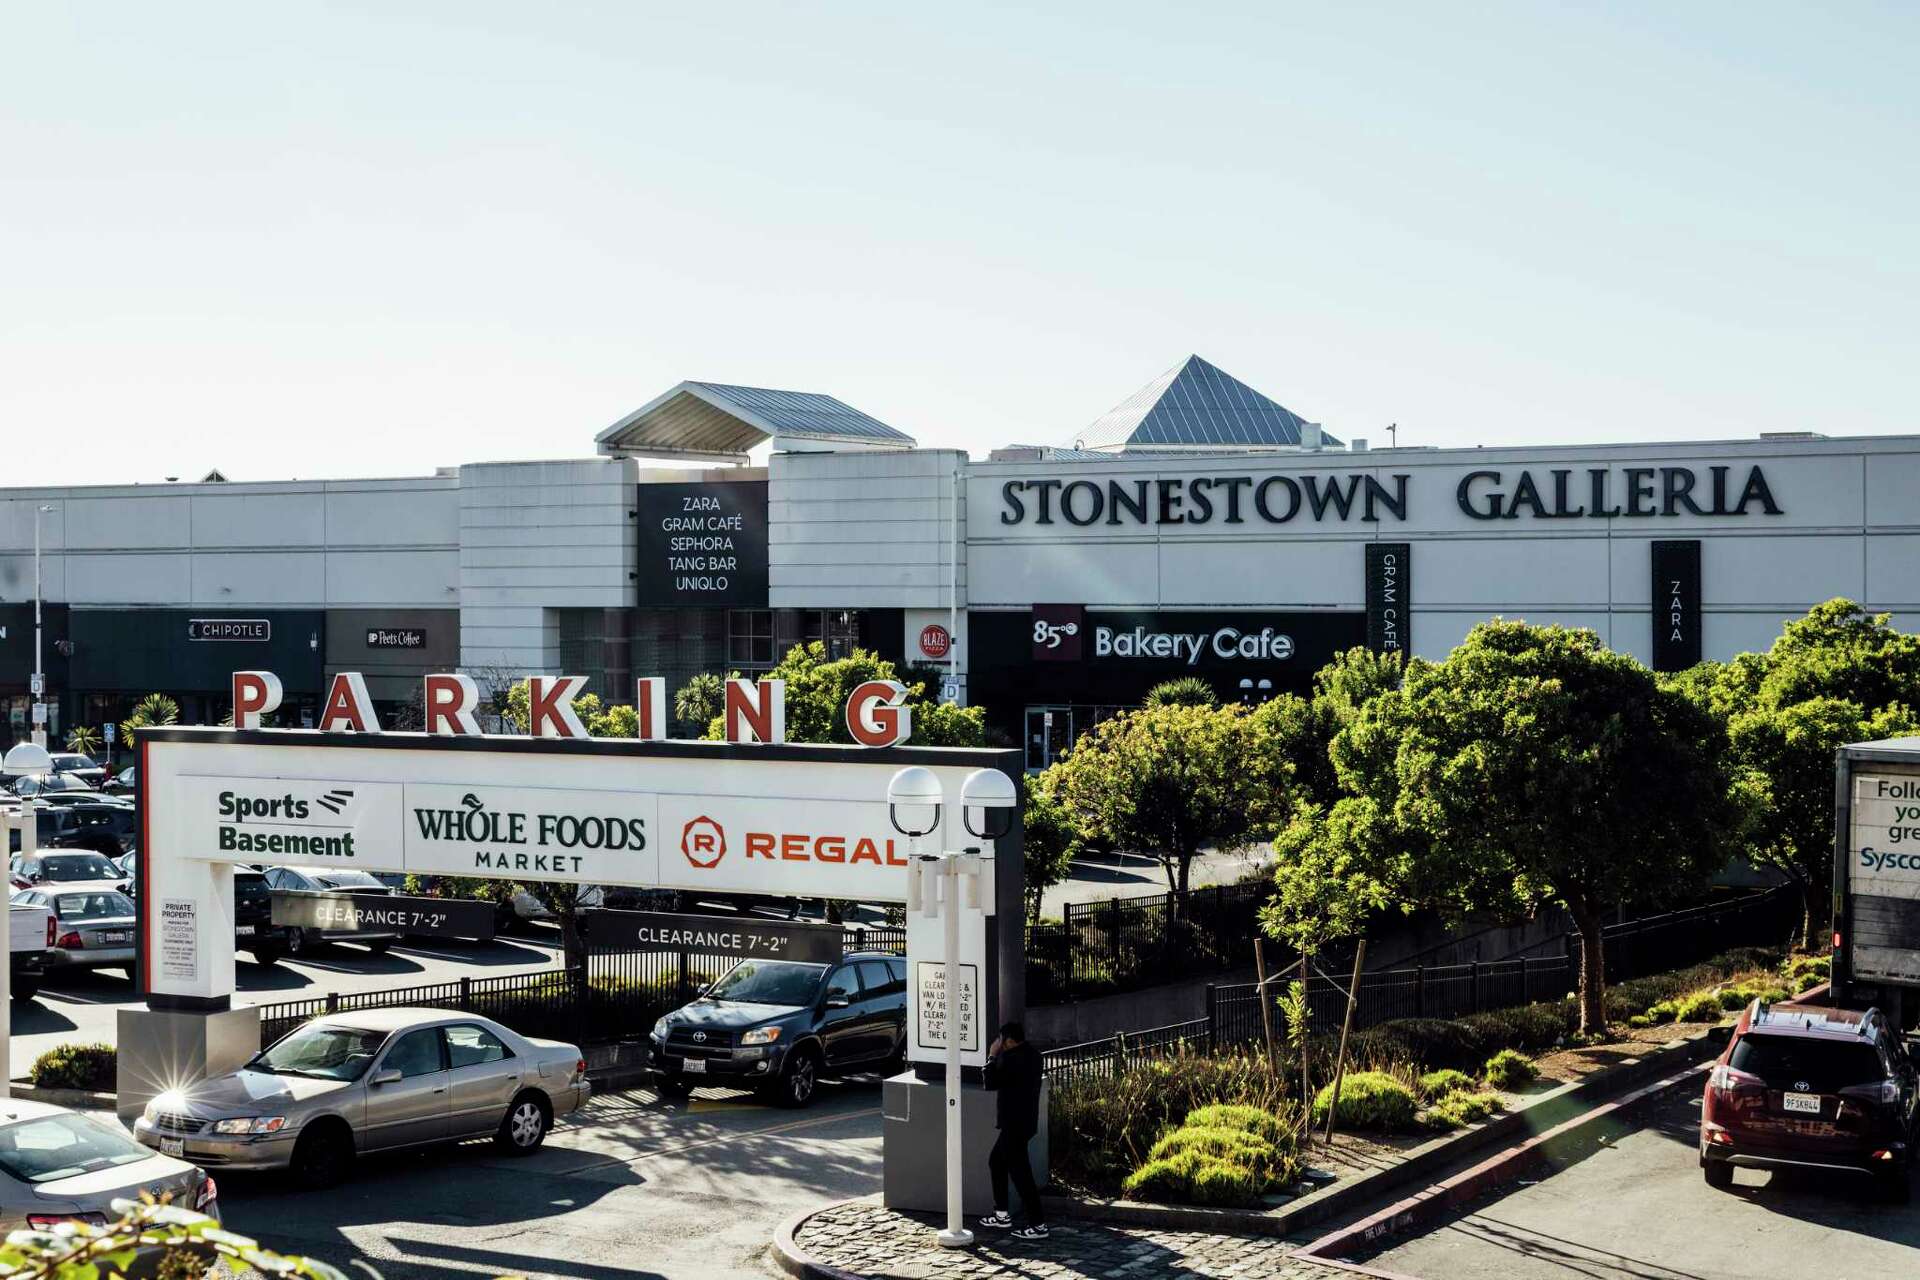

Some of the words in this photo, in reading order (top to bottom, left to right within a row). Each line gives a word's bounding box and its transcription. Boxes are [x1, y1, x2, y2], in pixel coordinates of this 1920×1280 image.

[682, 497, 721, 511] ZARA
[1001, 474, 1412, 527] STONESTOWN
[1456, 465, 1785, 521] GALLERIA
[662, 517, 705, 532] GRAM
[707, 513, 743, 531] CAFÉ
[671, 536, 734, 551] SEPHORA
[668, 556, 706, 571] TANG
[708, 556, 737, 571] BAR
[676, 576, 729, 591] UNIQLO
[1383, 554, 1397, 603] GRAM
[1670, 580, 1682, 642] ZARA
[202, 624, 263, 636] CHIPOTLE
[397, 631, 420, 646] Coffee
[923, 632, 946, 647] BLAZE
[1096, 626, 1207, 665] Bakery
[1212, 627, 1294, 659] Cafe
[947, 685, 957, 698] D
[232, 671, 912, 748] PARKING
[218, 791, 310, 823] Sports
[413, 799, 527, 844] WHOLE
[537, 814, 647, 851] FOODS
[218, 826, 355, 857] Basement
[745, 832, 908, 866] REGAL
[475, 851, 583, 873] MARKET
[1860, 846, 1920, 872] Sysco
[161, 911, 195, 919] PROPERTY
[165, 903, 192, 912] PRIVATE
[316, 906, 407, 925] CLEARANCE
[411, 913, 447, 928] 7'-2"
[638, 927, 742, 949] CLEARANCE
[748, 935, 788, 951] 7'-2"
